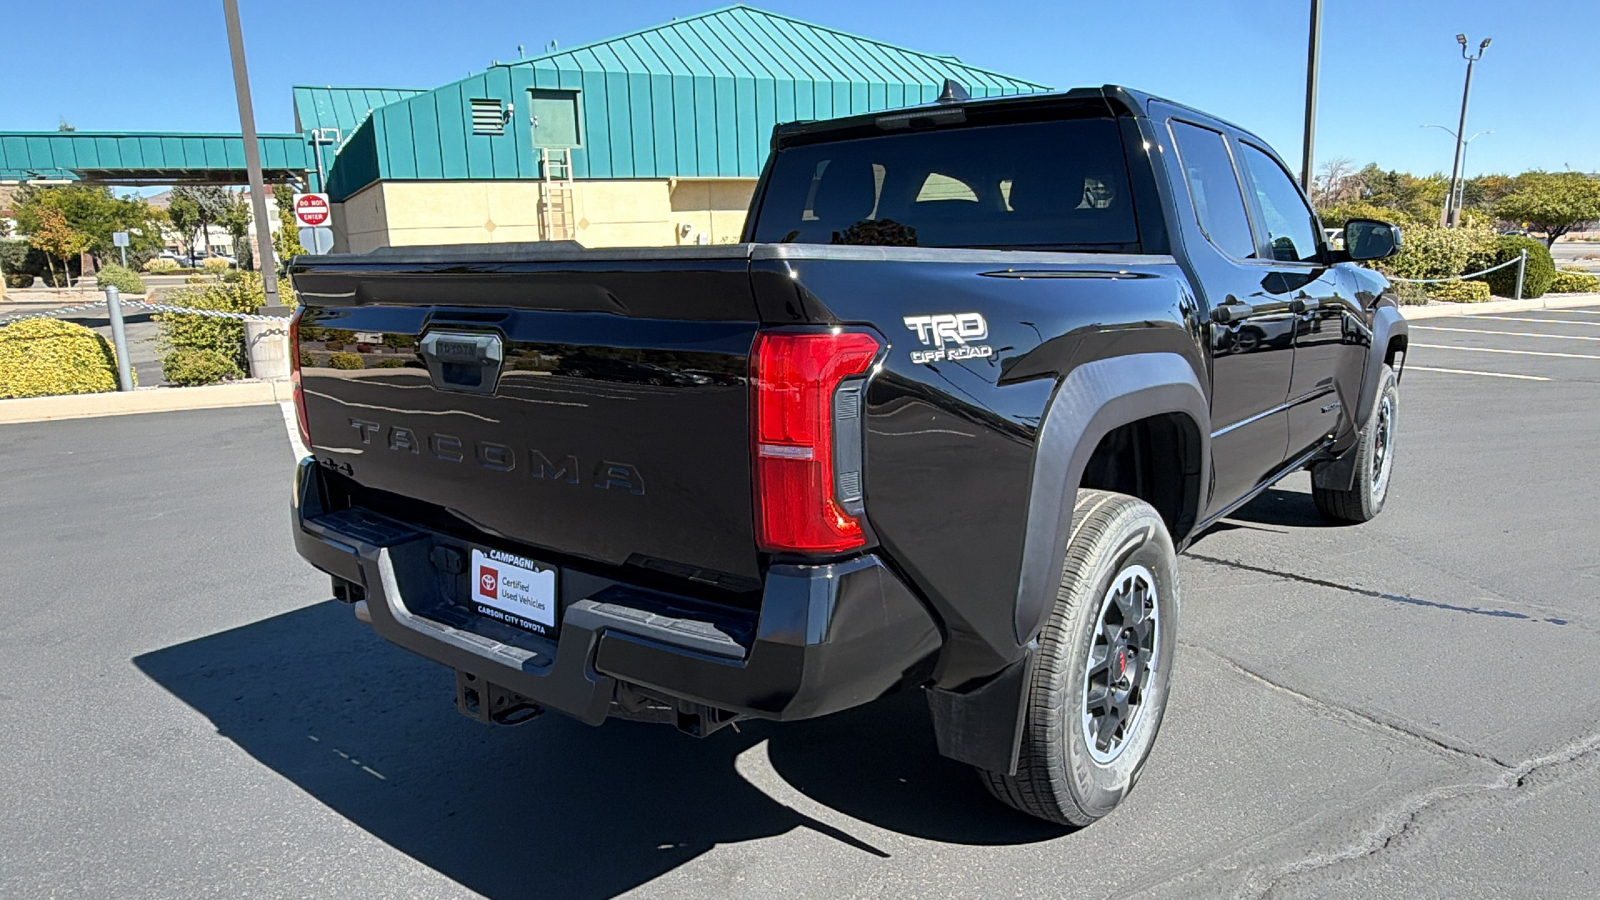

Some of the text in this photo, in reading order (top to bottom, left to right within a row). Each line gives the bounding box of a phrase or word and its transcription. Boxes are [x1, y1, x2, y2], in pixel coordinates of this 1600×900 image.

[903, 312, 988, 350] TRD
[910, 344, 993, 364] OFF ROAD
[349, 417, 645, 496] TACOMA
[489, 549, 534, 570] CAMPAGNI
[502, 576, 530, 593] Certified
[501, 588, 546, 611] Used Vehicles
[477, 605, 546, 634] CARSON CITY TOYOTA
